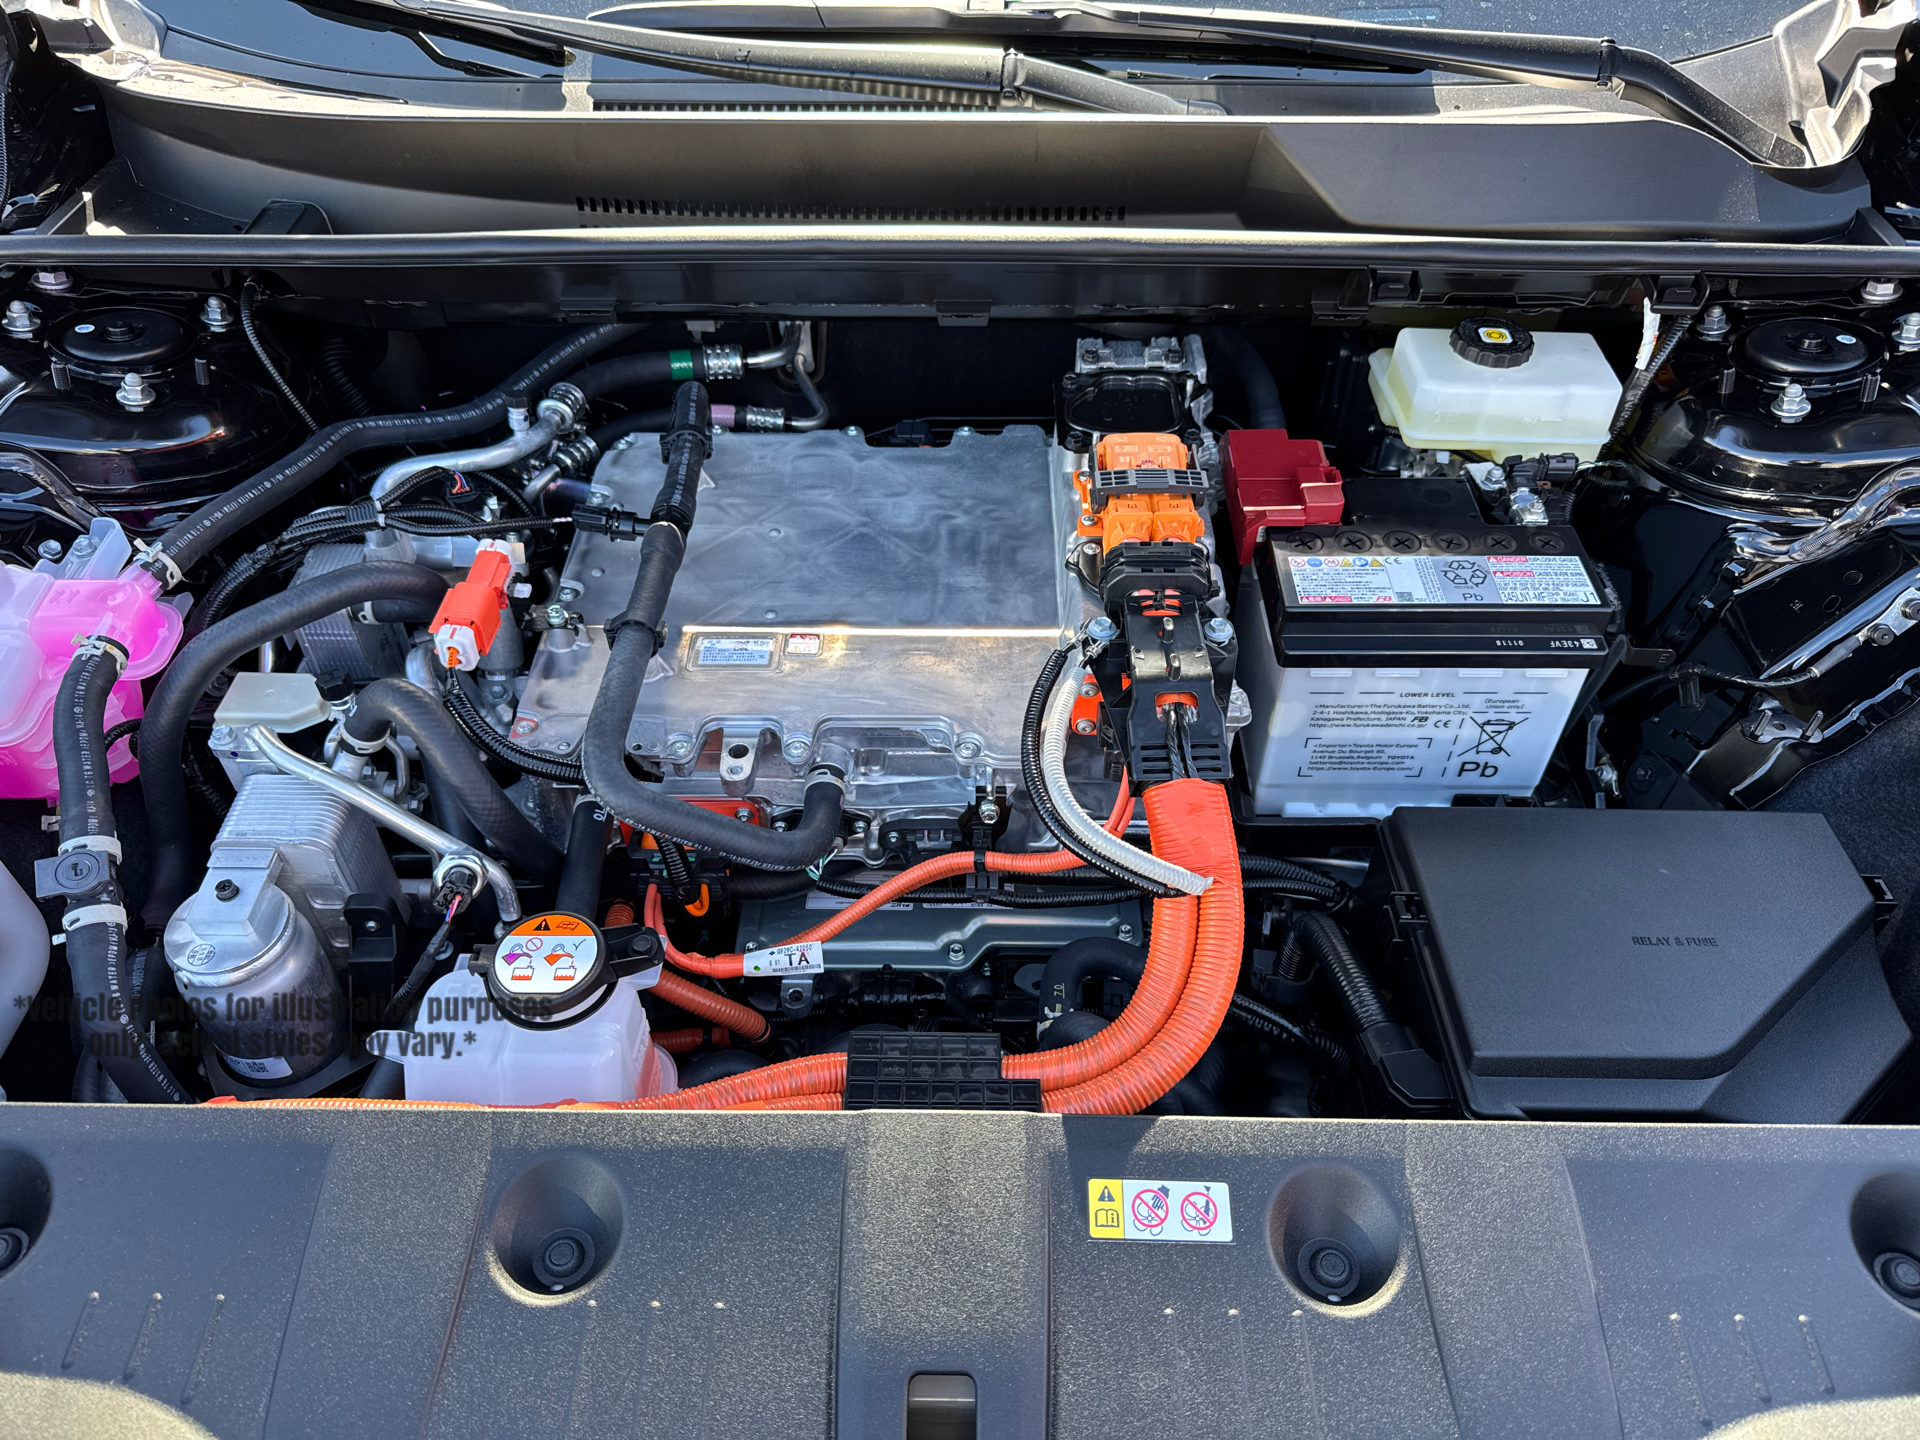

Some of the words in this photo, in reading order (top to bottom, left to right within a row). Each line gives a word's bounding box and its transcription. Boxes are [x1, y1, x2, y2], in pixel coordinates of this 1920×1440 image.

[1462, 593, 1483, 601] Pb
[77, 671, 91, 690] WATER
[80, 750, 93, 770] WATER
[1457, 761, 1498, 777] Pb
[1631, 936, 1671, 946] RELAY
[1674, 937, 1684, 946] &
[1685, 937, 1719, 947] FUSE
[784, 952, 810, 966] TA
[1054, 984, 1063, 996] 70
